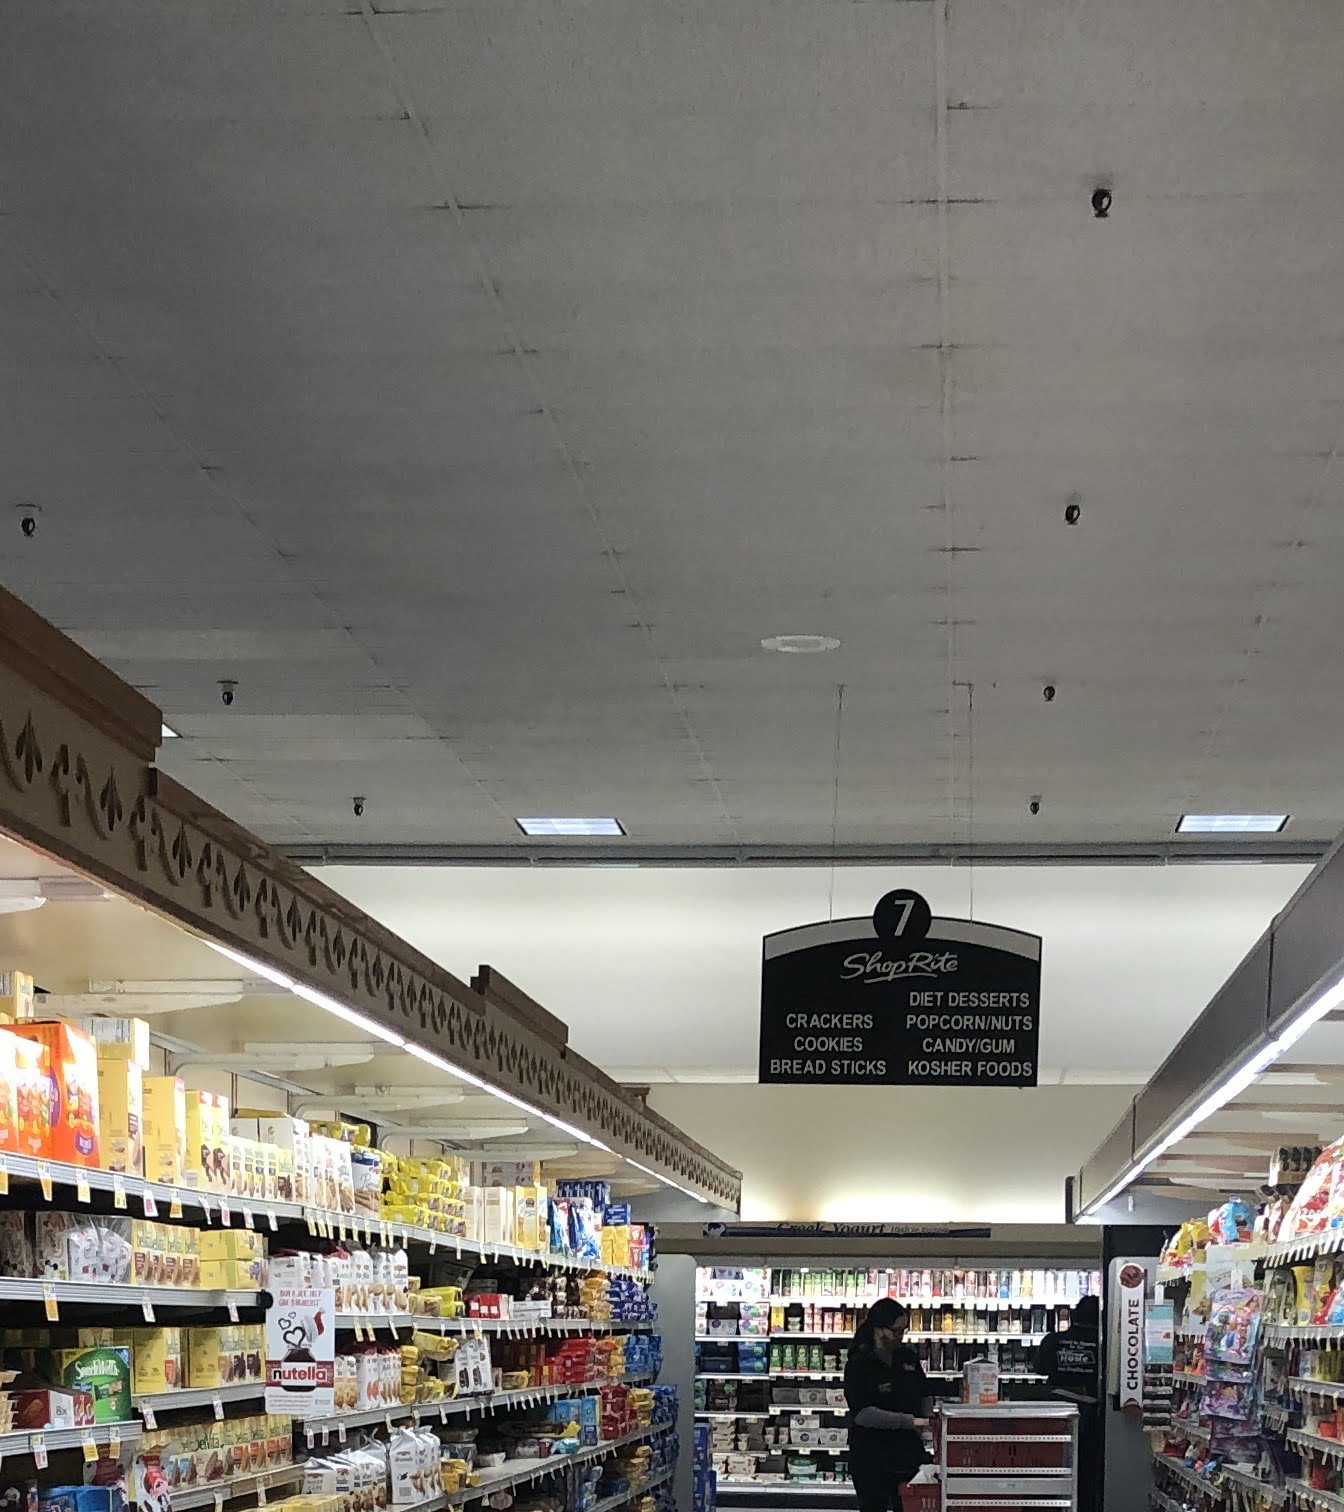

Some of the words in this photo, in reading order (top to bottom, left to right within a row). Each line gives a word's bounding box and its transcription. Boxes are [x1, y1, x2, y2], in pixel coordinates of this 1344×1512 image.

[894, 899, 916, 937] 7
[840, 951, 958, 983] ShopRite
[909, 991, 945, 1007] DIET
[948, 991, 1030, 1008] DESSERTS
[786, 1013, 874, 1029] CRACKERS
[906, 1014, 1033, 1031] POPCORN/NUTS
[793, 1036, 863, 1052] COOKIES
[922, 1037, 1016, 1054] CANDY/GUM
[770, 1059, 827, 1075] BREAD
[830, 1059, 887, 1076] STICKS
[908, 1060, 973, 1077] KOSHER
[976, 1060, 1033, 1077] FOODS
[1126, 1299, 1139, 1391] CHOCOLATE
[273, 1366, 327, 1381] nutella
[56, 1405, 68, 1416] 8x
